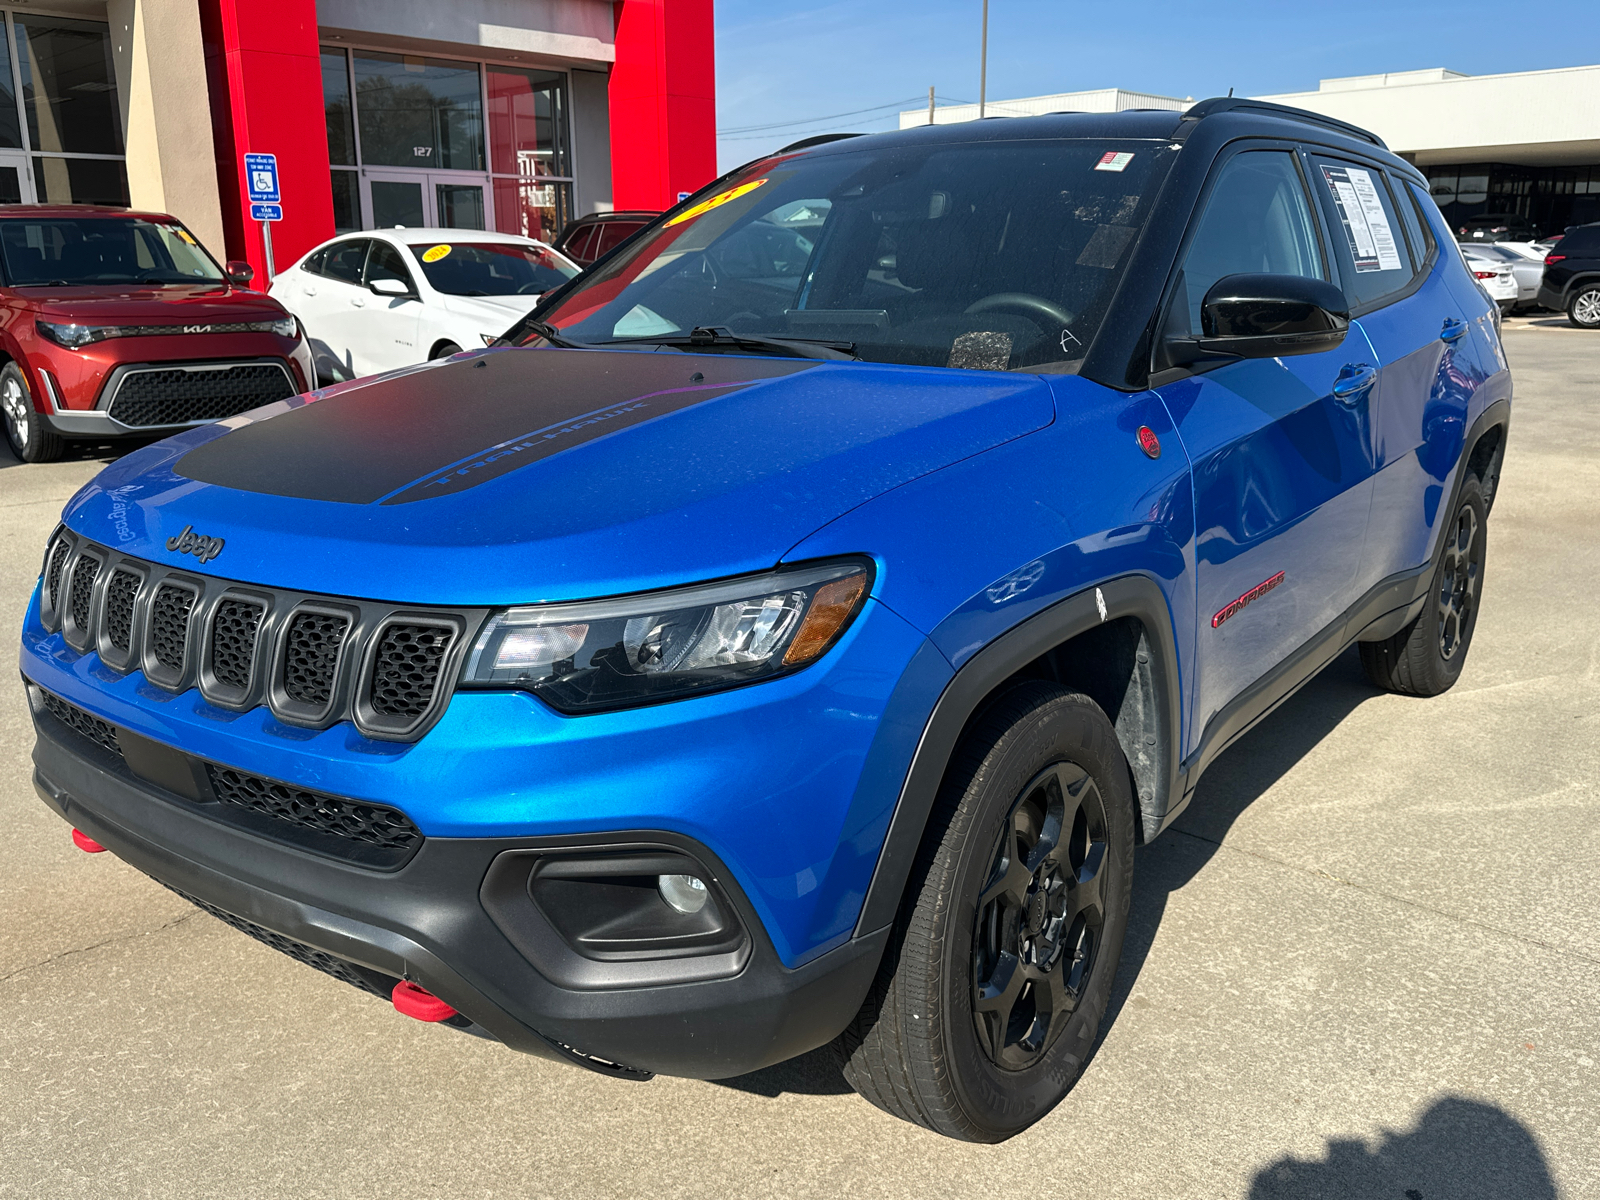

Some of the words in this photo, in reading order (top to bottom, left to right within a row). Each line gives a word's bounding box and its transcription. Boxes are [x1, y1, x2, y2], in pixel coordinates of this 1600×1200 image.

[413, 146, 433, 157] 127
[183, 324, 211, 334] KIA
[1060, 329, 1082, 352] A
[422, 401, 651, 489] TRAILHAWK
[165, 524, 226, 565] Jeep
[1211, 569, 1285, 629] COMPASS
